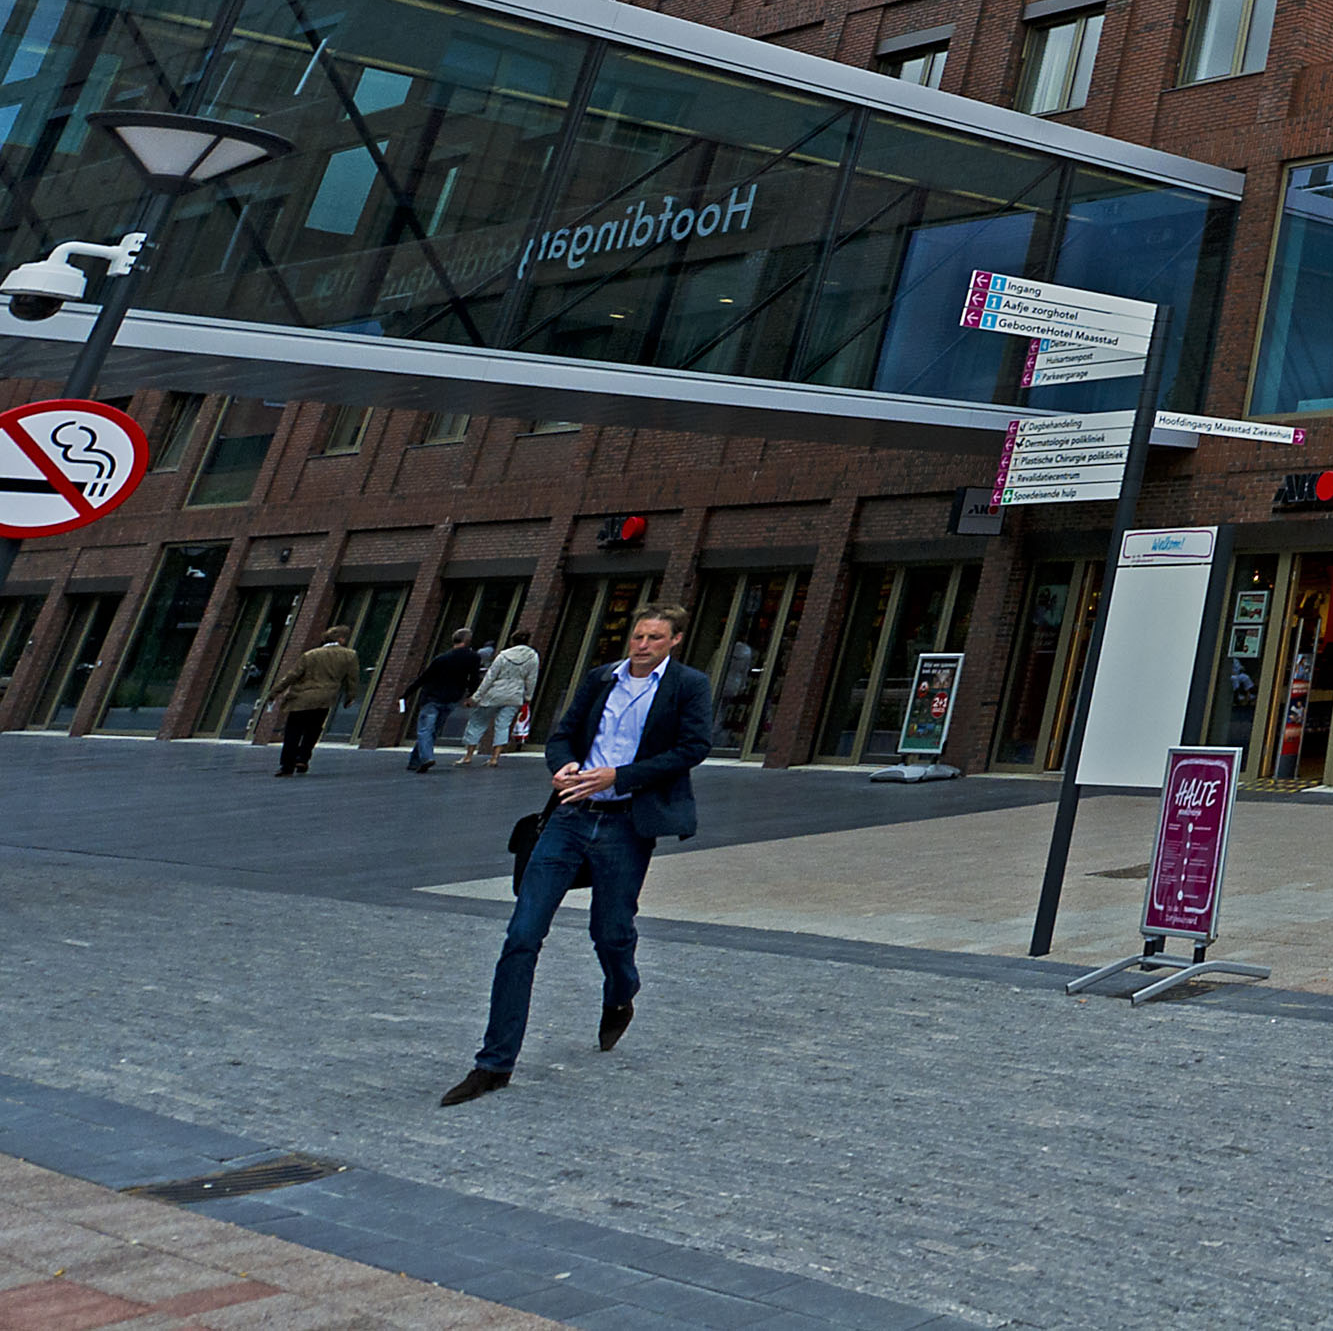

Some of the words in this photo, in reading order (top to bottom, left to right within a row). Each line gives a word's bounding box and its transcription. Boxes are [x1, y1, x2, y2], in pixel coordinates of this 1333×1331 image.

[1007, 281, 1042, 298] Ingang
[1002, 298, 1030, 313] Aafje
[1031, 305, 1079, 321] zorghotel
[998, 318, 1074, 339] GeboorteHotel
[1075, 330, 1119, 347] Maasstad
[1045, 352, 1094, 365] Huisartsenpost
[1041, 369, 1089, 382] Parkeergarage
[1028, 420, 1083, 433] Dagbehandeling
[1158, 415, 1212, 431] Hoofdingang
[1213, 422, 1251, 435] Maasstad
[1252, 427, 1292, 440] Ziekenhuis
[1024, 436, 1070, 448] Dermatologie
[1071, 433, 1105, 446] polikliniek
[1020, 454, 1053, 465] Plastische
[1054, 453, 1086, 465] Chirurgie
[1087, 450, 1124, 462] polikliniek
[1016, 471, 1081, 483] Revalidatiecentrum
[1013, 488, 1061, 501] Spoedeisende
[1061, 488, 1077, 500] hulp
[932, 696, 948, 708] 2+1
[1175, 778, 1221, 808] HALTE
